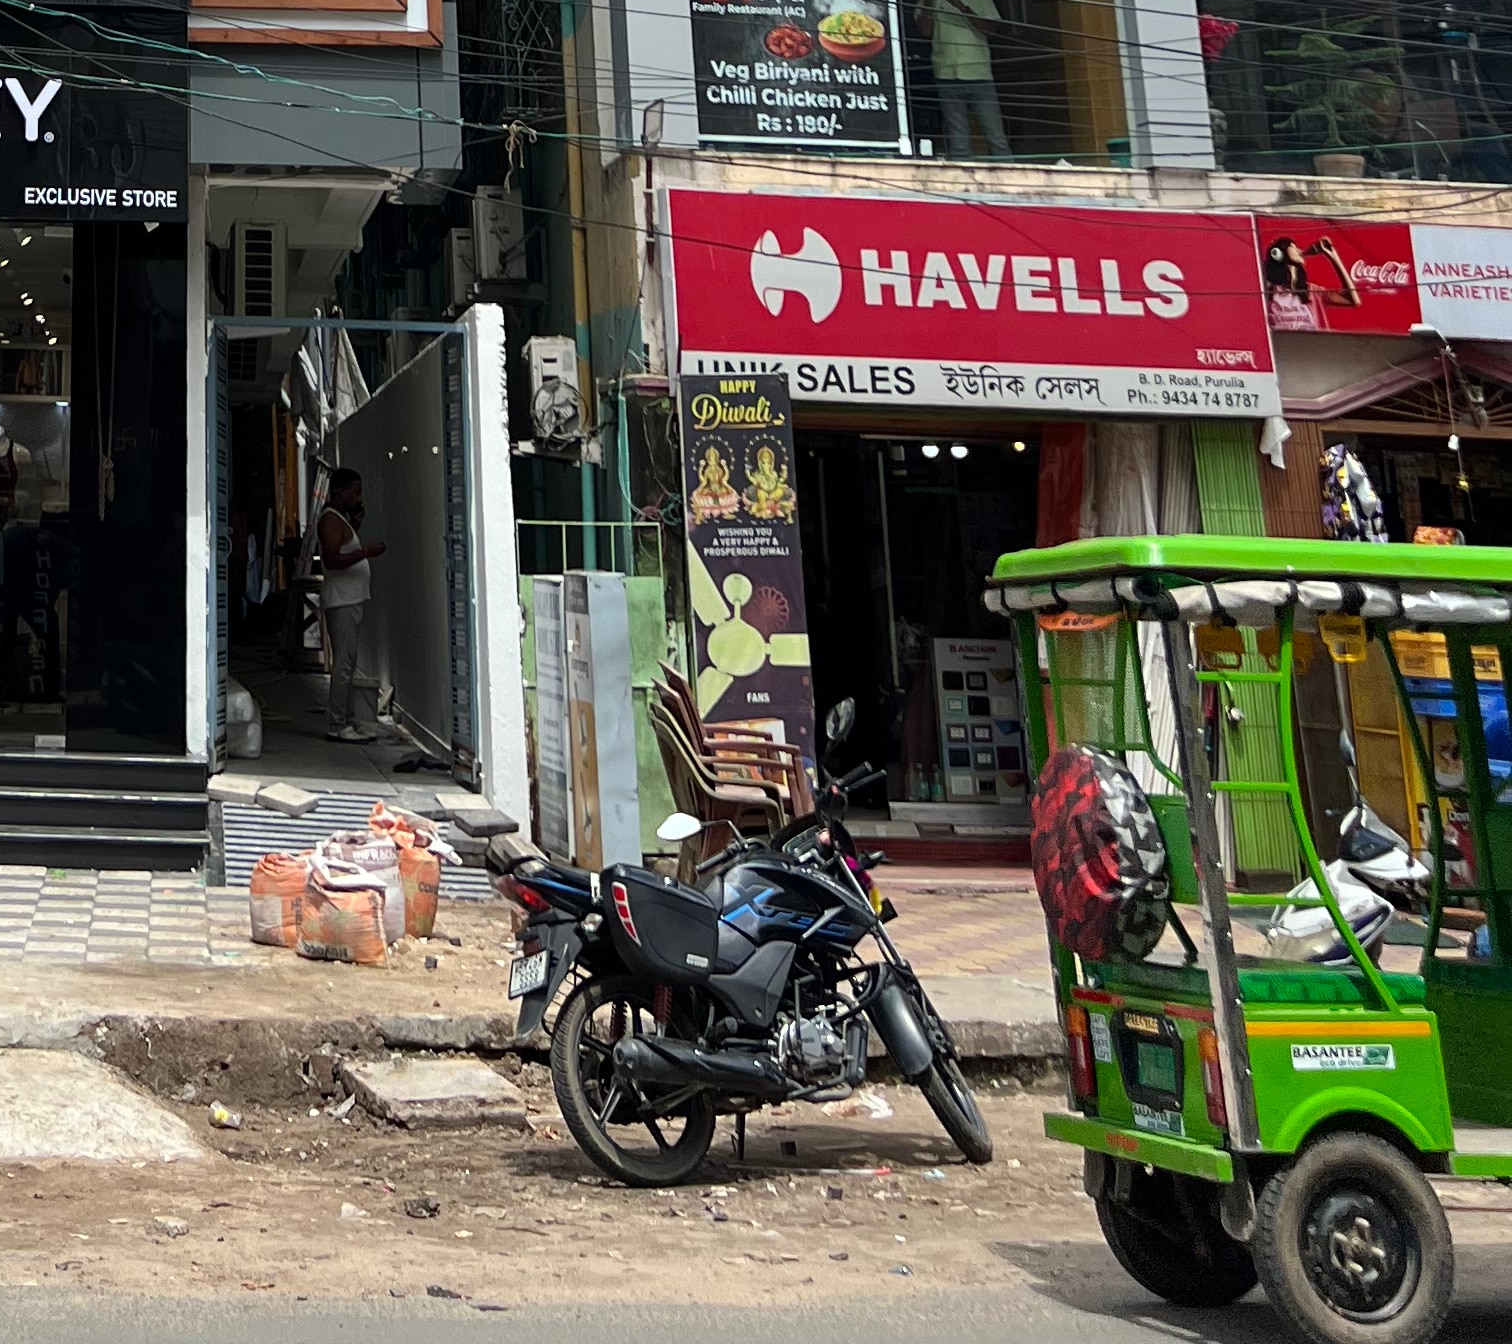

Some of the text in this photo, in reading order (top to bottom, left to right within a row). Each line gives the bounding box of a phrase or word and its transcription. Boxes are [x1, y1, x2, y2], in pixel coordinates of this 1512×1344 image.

[692, 1, 806, 19] Family Restaurant (AC)
[710, 60, 880, 86] Veg Biriyani with
[706, 85, 889, 112] Chilli Chicken Just
[757, 113, 782, 132] Rs
[23, 186, 178, 209] EXCLUSIVE STORE
[1422, 262, 1512, 279] ANNEASH
[859, 248, 1190, 319] HAVELLS
[719, 380, 756, 395] HAPPY
[797, 362, 916, 395] SALES
[939, 364, 1026, 401] ইউনিক
[1138, 372, 1151, 385] B.
[1153, 373, 1167, 386] D.
[1169, 374, 1202, 388] Road,
[1161, 390, 1198, 406] 9434
[1201, 391, 1221, 407] 74
[1224, 393, 1259, 408] 8787
[691, 394, 773, 430] Diwali
[717, 527, 772, 537] WISHING YOU
[719, 537, 742, 547] VERY
[743, 537, 772, 547] HAPPY
[703, 546, 790, 557] PROSPEROUS DIWALI
[746, 691, 771, 704] FANS
[1292, 1045, 1362, 1059] BASANTEE
